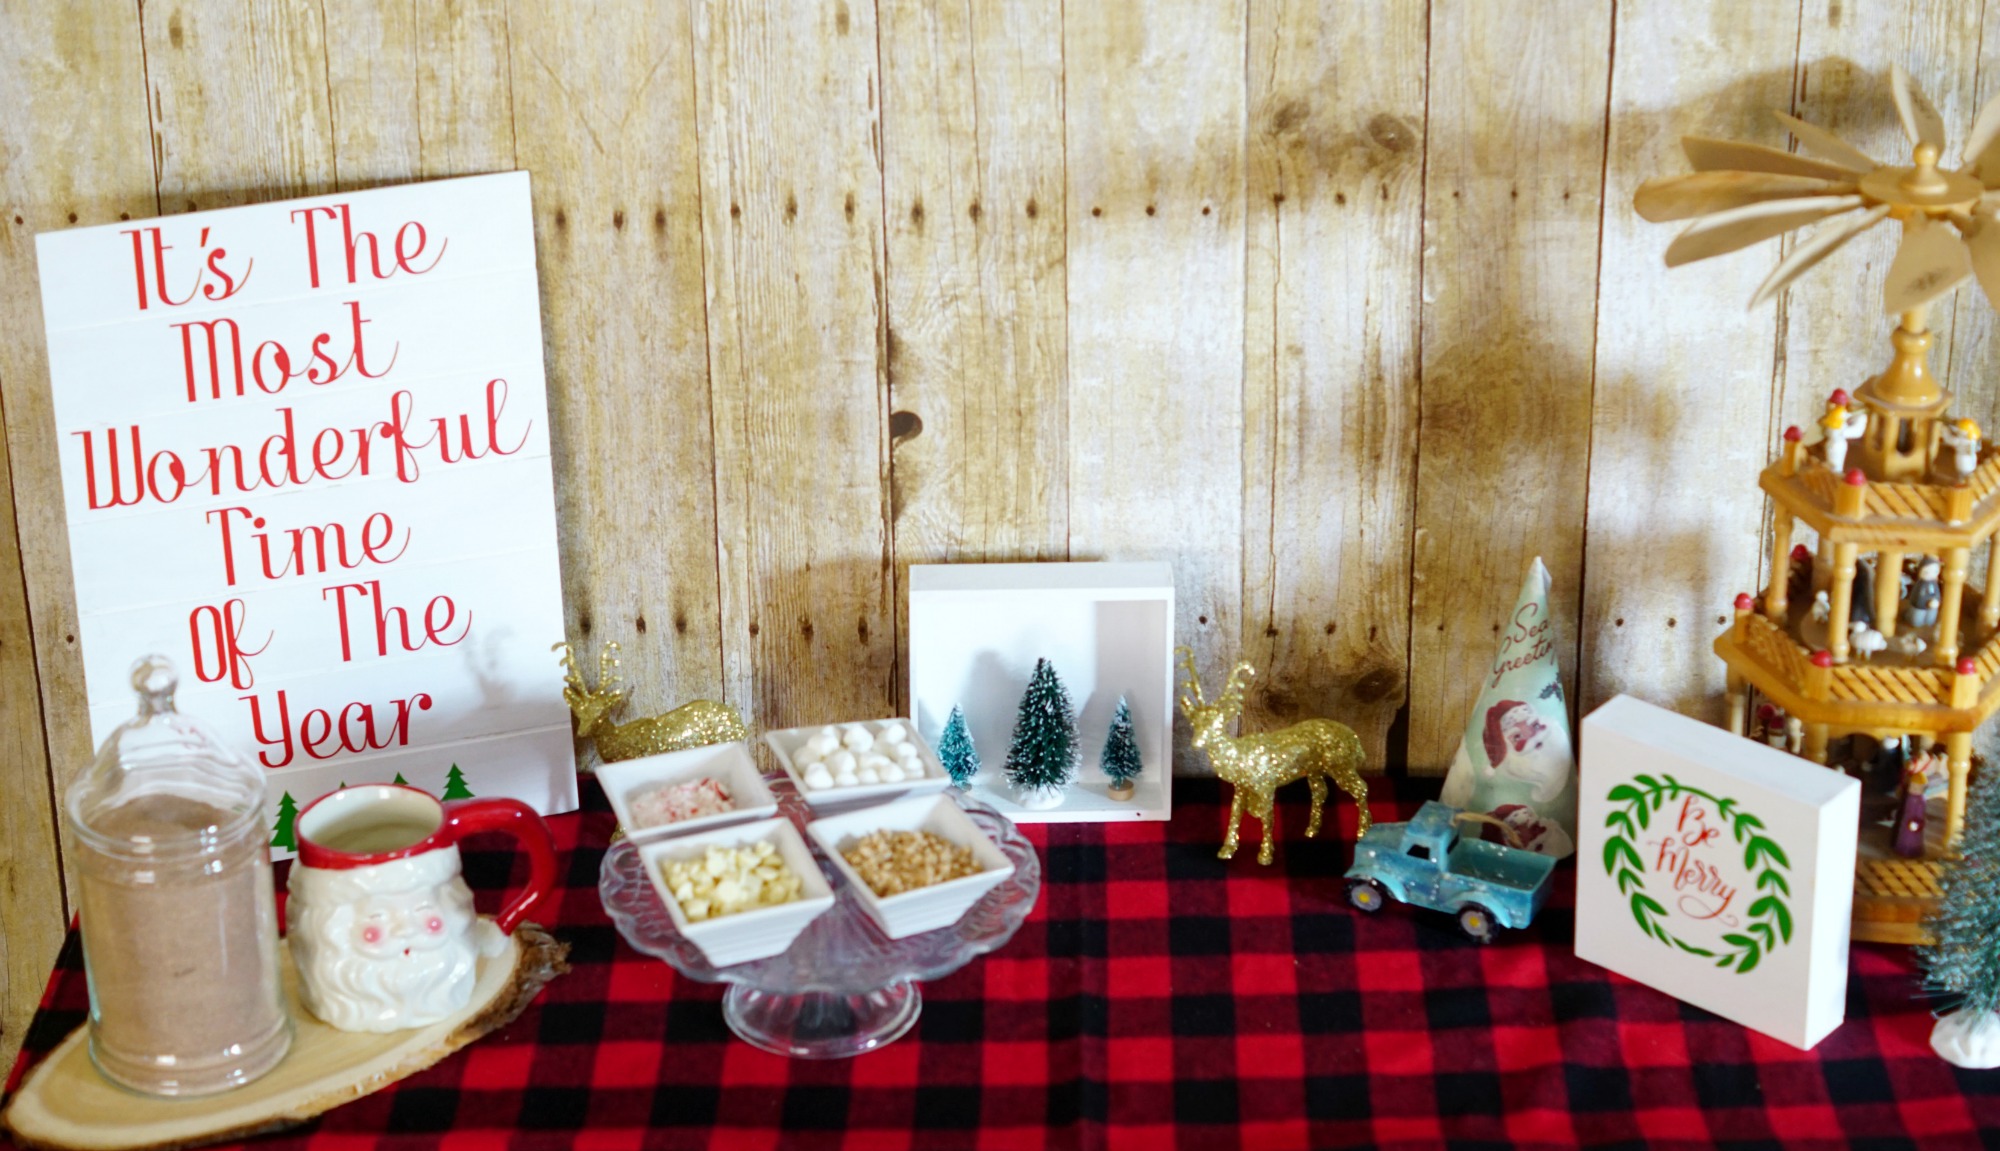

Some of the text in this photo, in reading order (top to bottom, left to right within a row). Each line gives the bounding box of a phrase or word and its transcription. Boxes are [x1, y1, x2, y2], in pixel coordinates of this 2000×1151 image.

[120, 202, 448, 311] It's The
[169, 300, 400, 403] Most
[71, 377, 533, 511] Wonderful
[206, 506, 411, 587] Time
[188, 580, 473, 691] Of The
[239, 689, 433, 770] Year
[1677, 794, 1720, 848] Be
